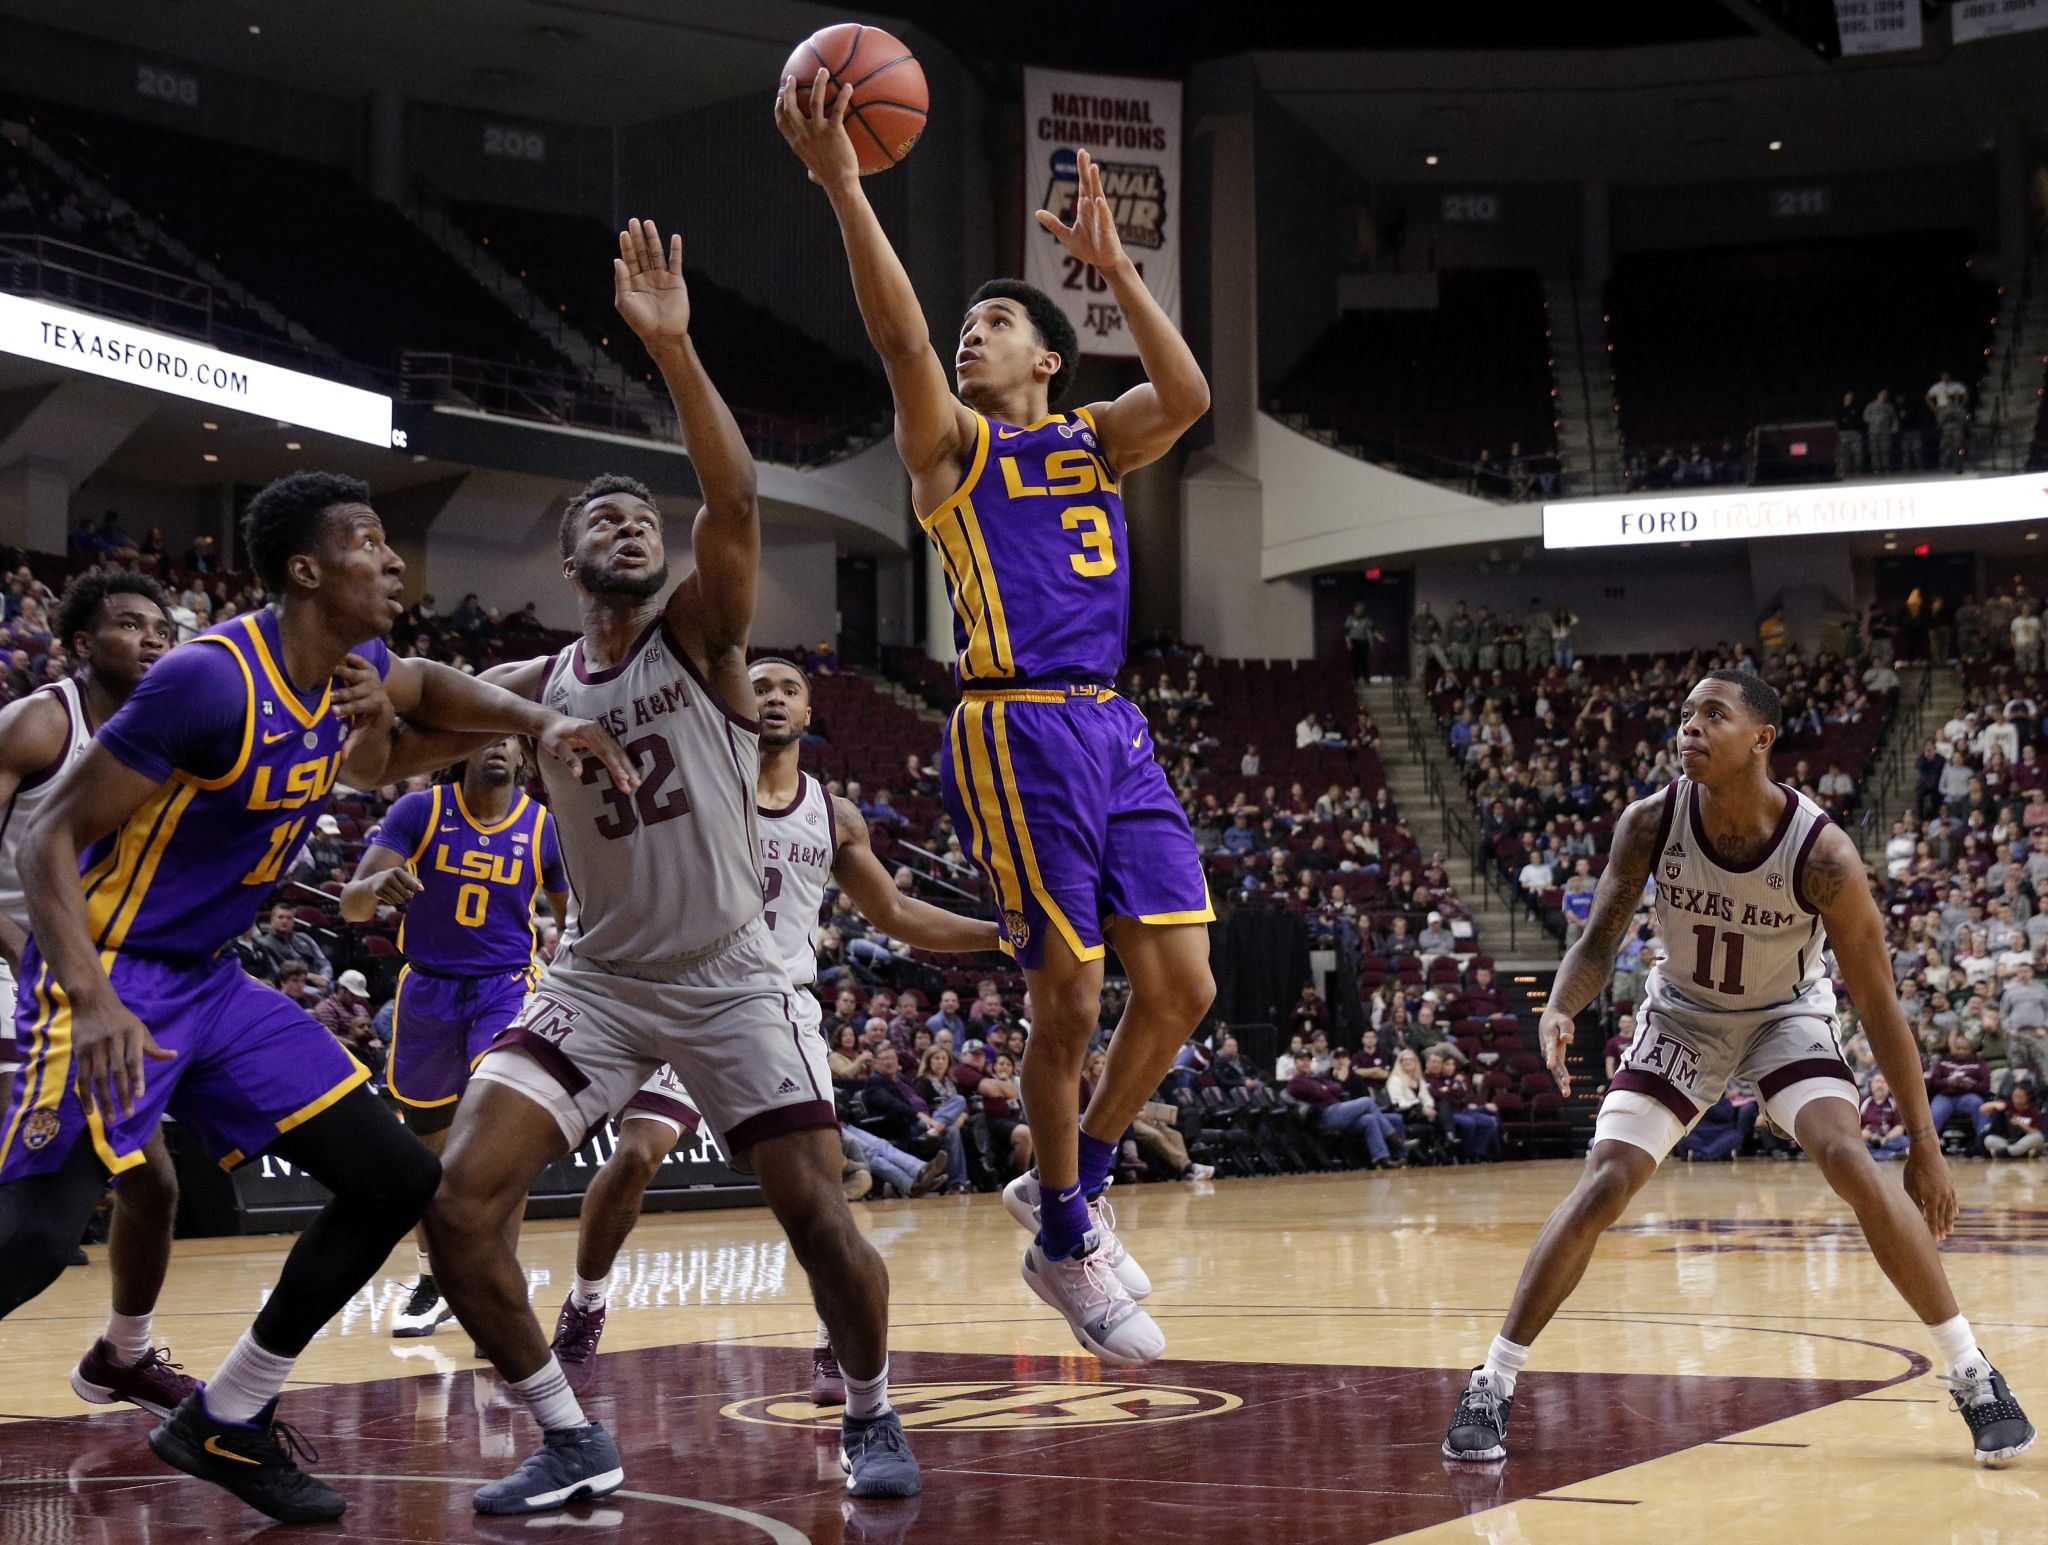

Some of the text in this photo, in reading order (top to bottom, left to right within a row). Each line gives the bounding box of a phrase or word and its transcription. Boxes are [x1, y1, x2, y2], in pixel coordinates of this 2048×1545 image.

[1052, 93, 1152, 124] NATIONAL
[1038, 117, 1166, 150] CHAMPIONS
[40, 321, 248, 395] TEXASFORD.COM
[1621, 496, 1917, 535] FORD TRUCK MONTH
[1060, 505, 1117, 577] 3
[633, 680, 690, 726] A&M
[1070, 684, 1098, 696] LSU
[246, 751, 343, 810] LSU
[580, 733, 690, 840] 32
[241, 816, 307, 886] 11
[435, 843, 523, 885] LSU
[788, 842, 826, 867] A&M
[1768, 874, 1783, 888] SEC
[455, 883, 489, 928] 0
[1656, 881, 1795, 928] TEXAS A&M
[1692, 924, 1745, 994] 11
